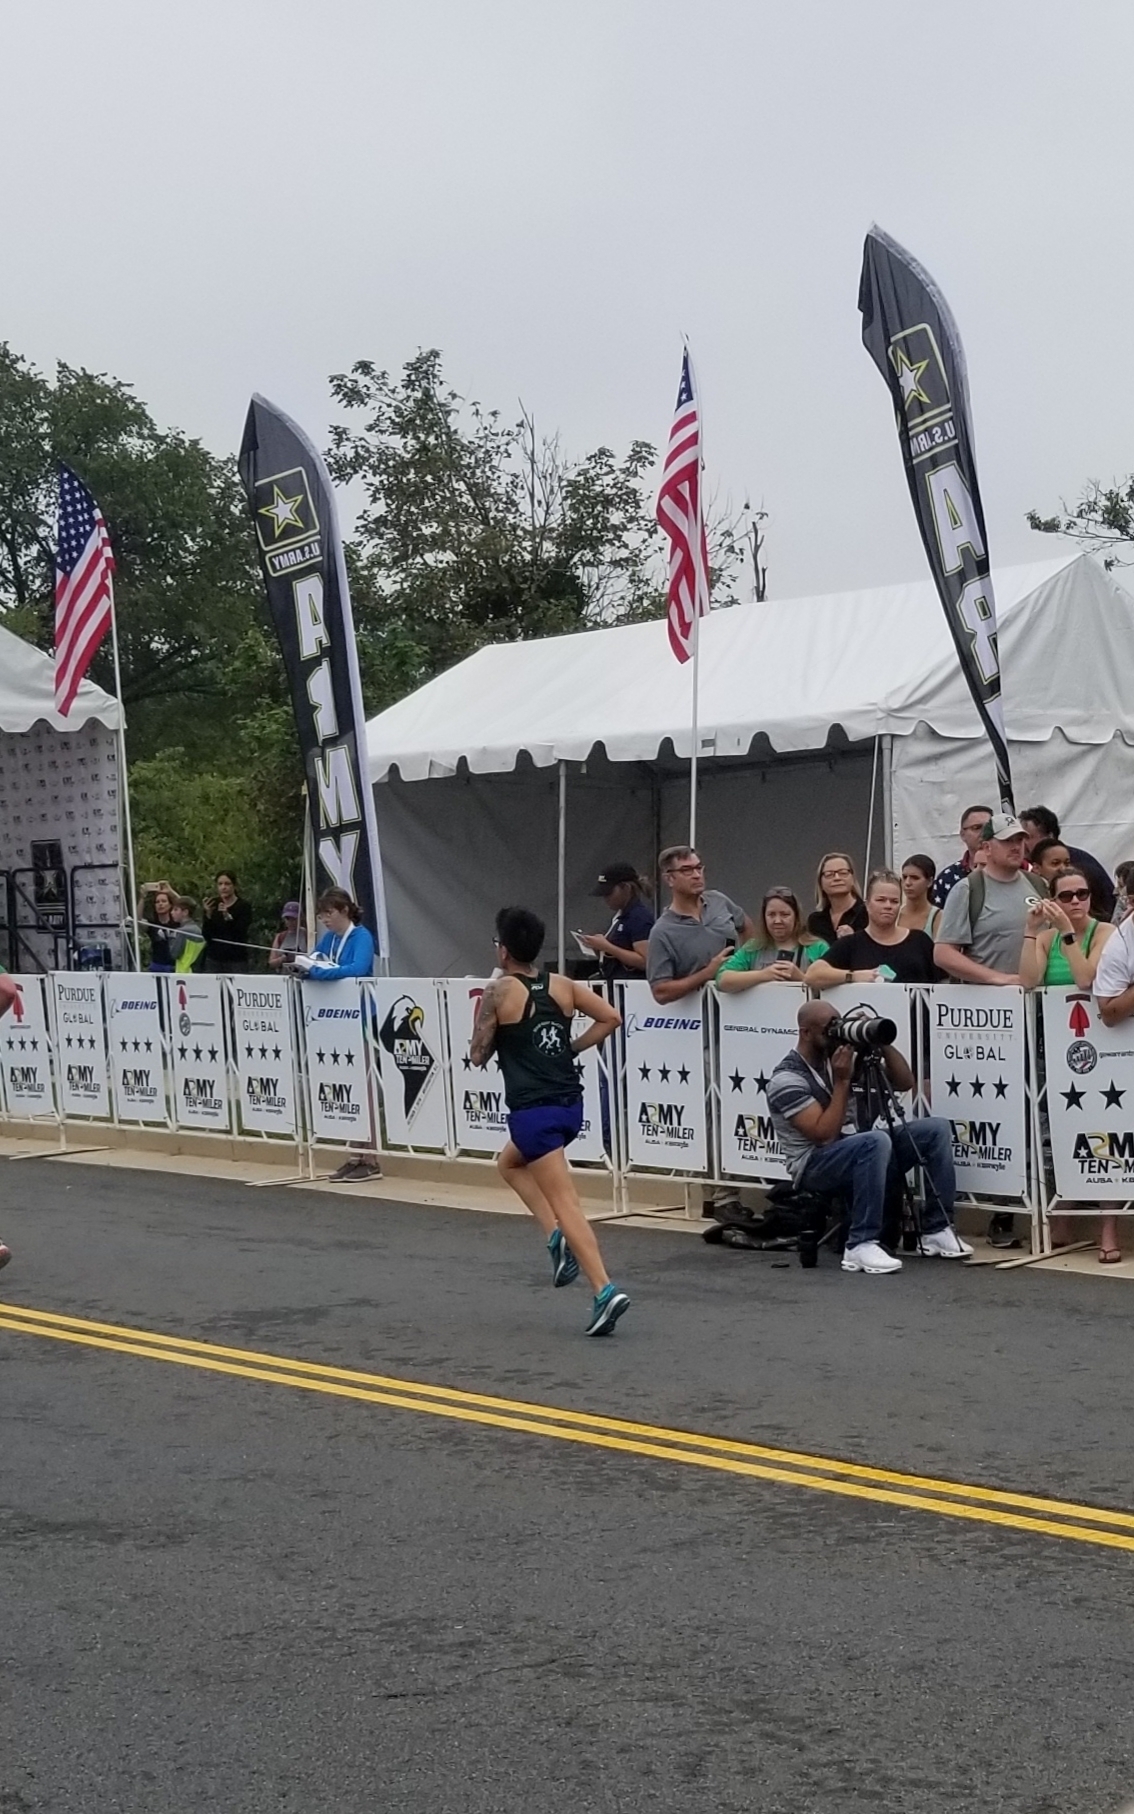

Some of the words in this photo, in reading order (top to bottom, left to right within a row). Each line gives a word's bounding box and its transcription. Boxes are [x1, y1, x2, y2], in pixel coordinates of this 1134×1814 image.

[57, 984, 96, 1002] PURDUE
[236, 988, 282, 1009] PURDUE
[120, 1000, 157, 1010] BOEING
[317, 1008, 361, 1019] BOEING
[643, 1017, 702, 1031] BOEING
[936, 1003, 1014, 1028] PURDUE
[724, 1024, 759, 1034] GENERAL
[760, 1027, 799, 1036] DYNAMIC
[937, 1031, 1014, 1041] UNIVERSITY
[393, 1039, 423, 1055] ARMY
[10, 1066, 38, 1083] ARMY
[66, 1064, 94, 1083] ARMY
[122, 1068, 151, 1087] ARMY
[183, 1077, 215, 1098] ARMY
[246, 1076, 279, 1097] ARMY
[318, 1082, 353, 1103] ARMY
[185, 1096, 223, 1110] TEN-MILER
[248, 1094, 287, 1108] TEN-MILER
[320, 1101, 361, 1115] TEN-MILER
[463, 1089, 502, 1112] ARMY
[465, 1110, 507, 1125] TEN-MILE
[638, 1101, 685, 1127] ARMY
[641, 1124, 694, 1141] TEN-MILER
[734, 1114, 775, 1141] ARM
[737, 1137, 787, 1155] TEN-MIL
[951, 1143, 1013, 1162] EN-MILER
